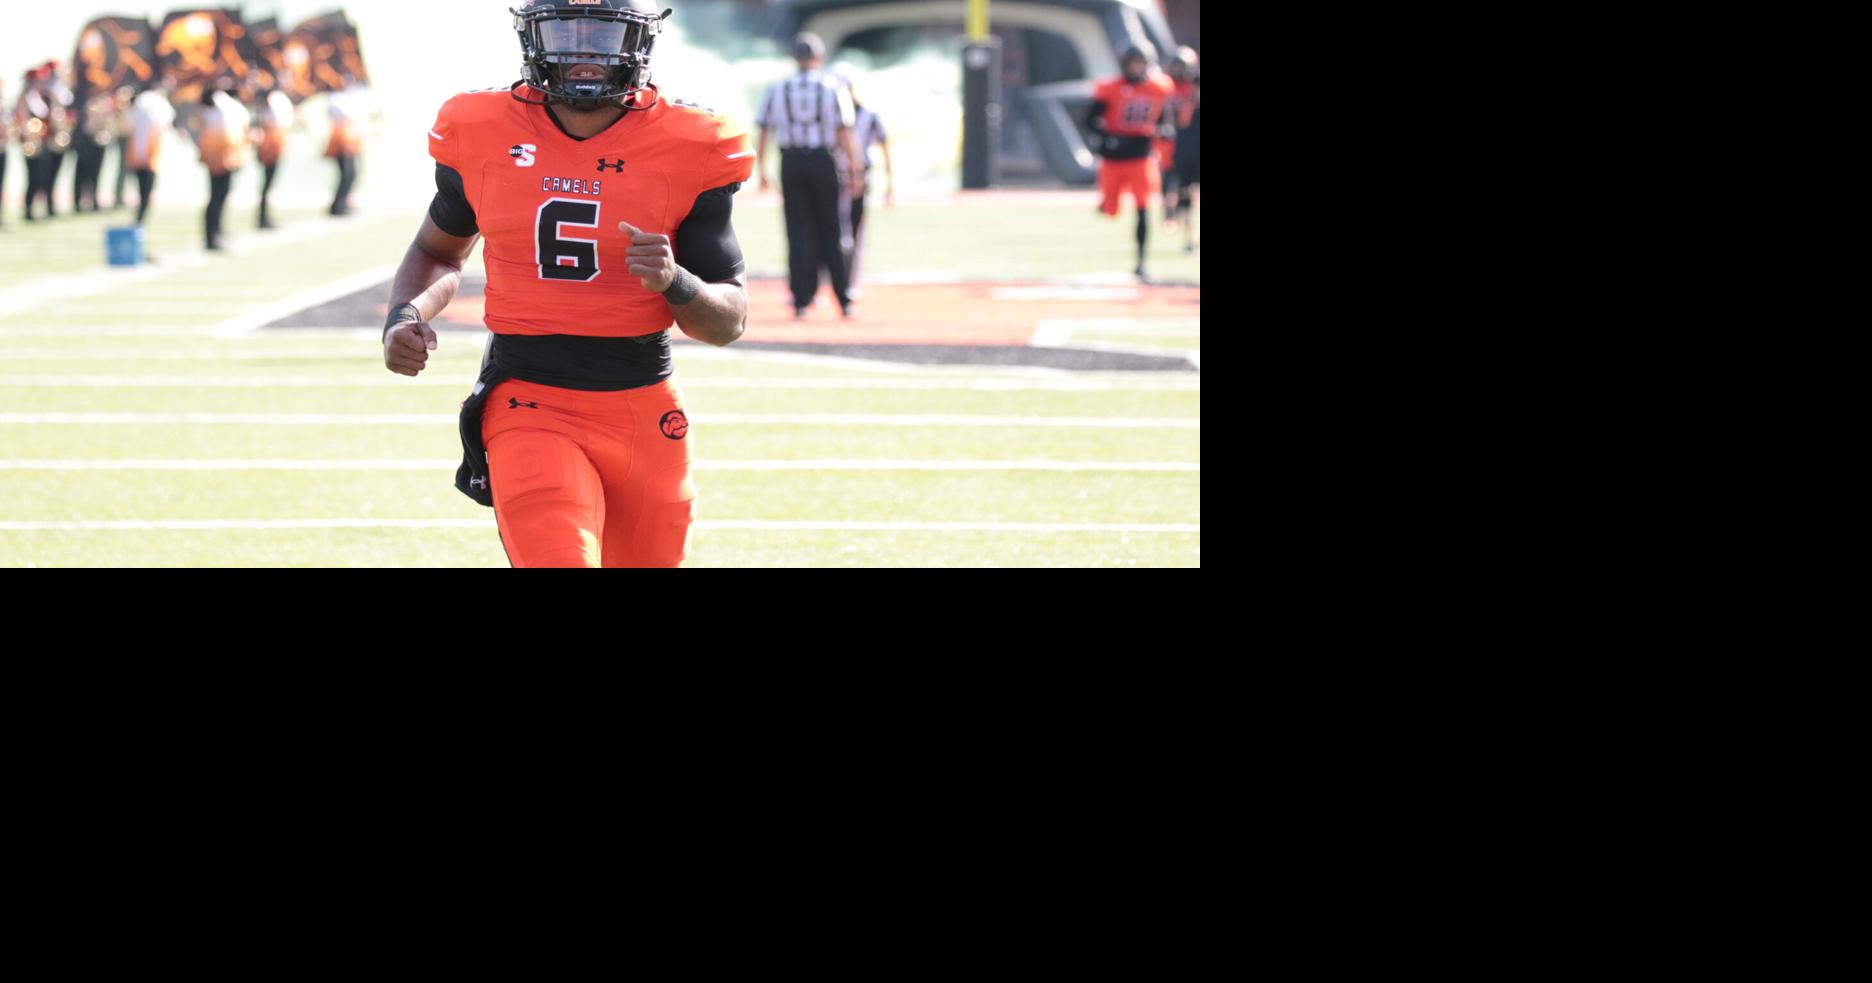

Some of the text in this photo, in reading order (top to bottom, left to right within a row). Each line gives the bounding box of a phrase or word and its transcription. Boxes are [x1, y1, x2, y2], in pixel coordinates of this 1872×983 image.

[515, 144, 537, 167] S
[542, 177, 602, 196] CAMELS
[535, 197, 601, 282] 6
